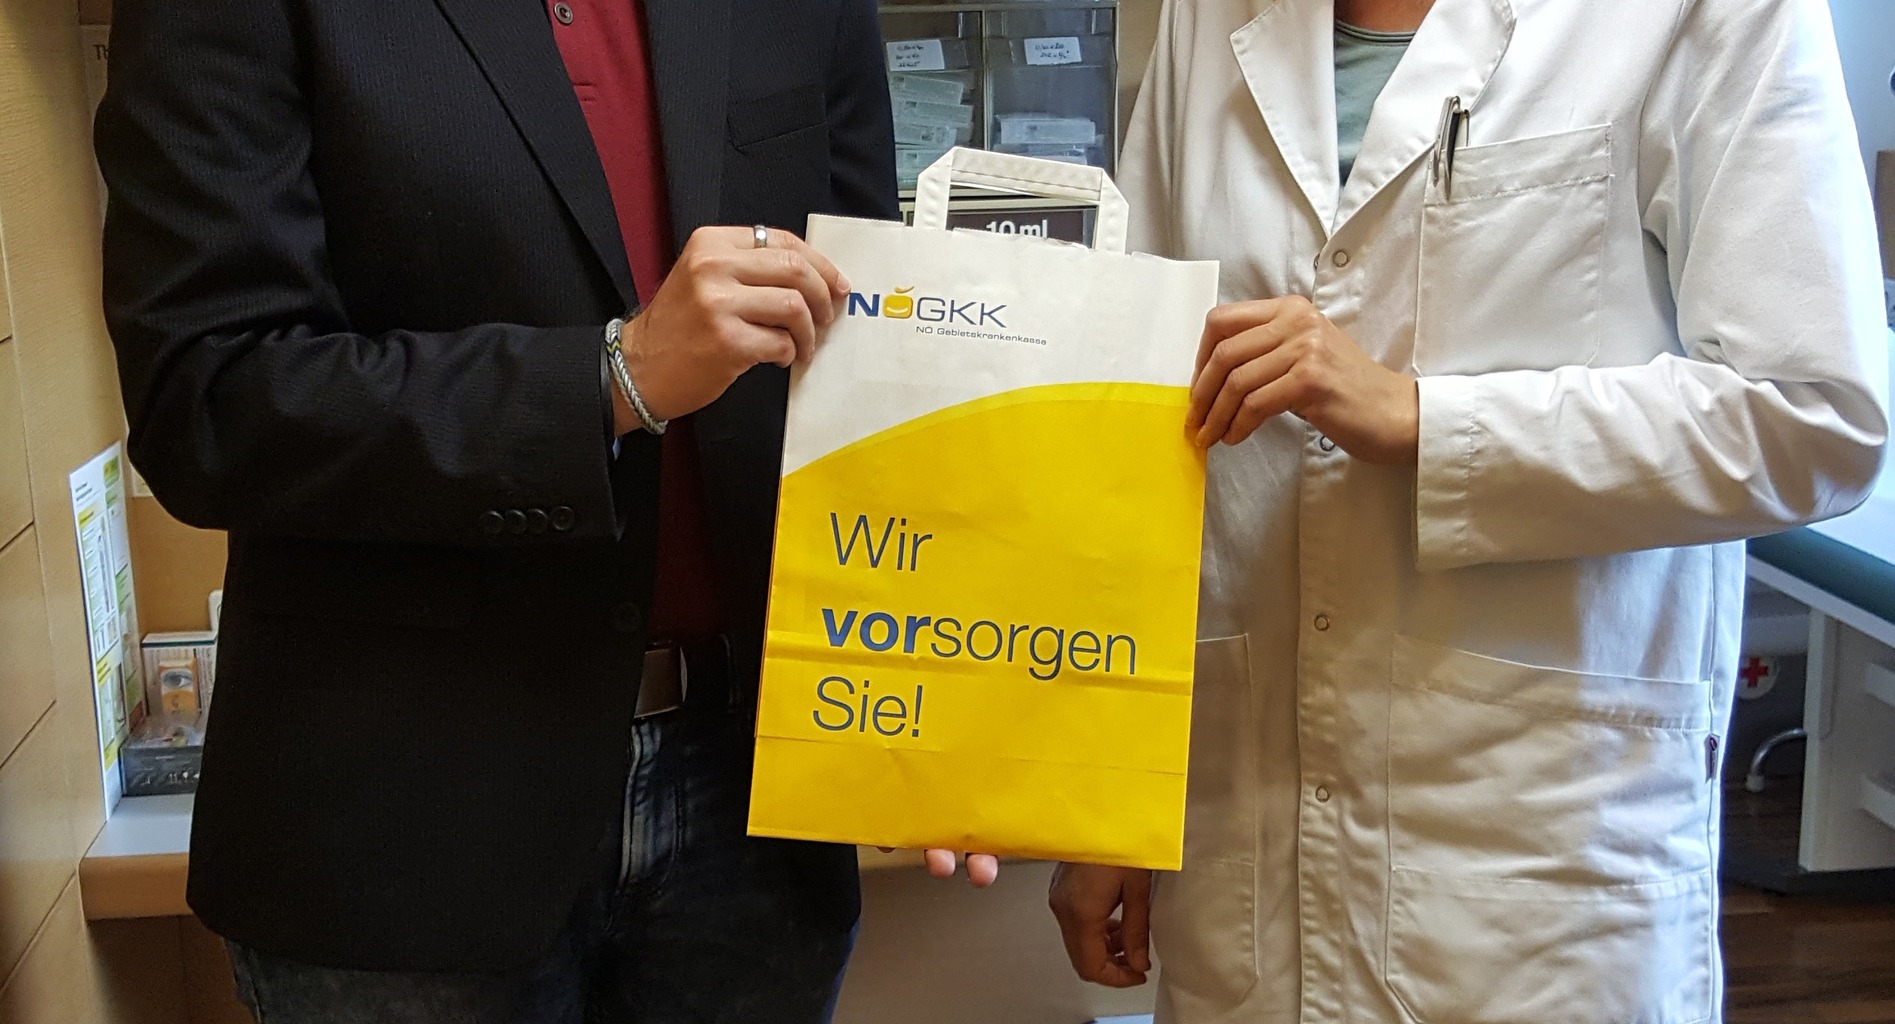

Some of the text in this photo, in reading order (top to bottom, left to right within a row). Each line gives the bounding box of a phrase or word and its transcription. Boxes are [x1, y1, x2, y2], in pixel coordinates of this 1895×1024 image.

[985, 219, 1049, 239] 10 ml
[936, 327, 1048, 346] Gebietskrankenkasse
[829, 512, 933, 572] Wir
[821, 608, 1137, 681] vorsorgen
[812, 676, 924, 738] Sie!
